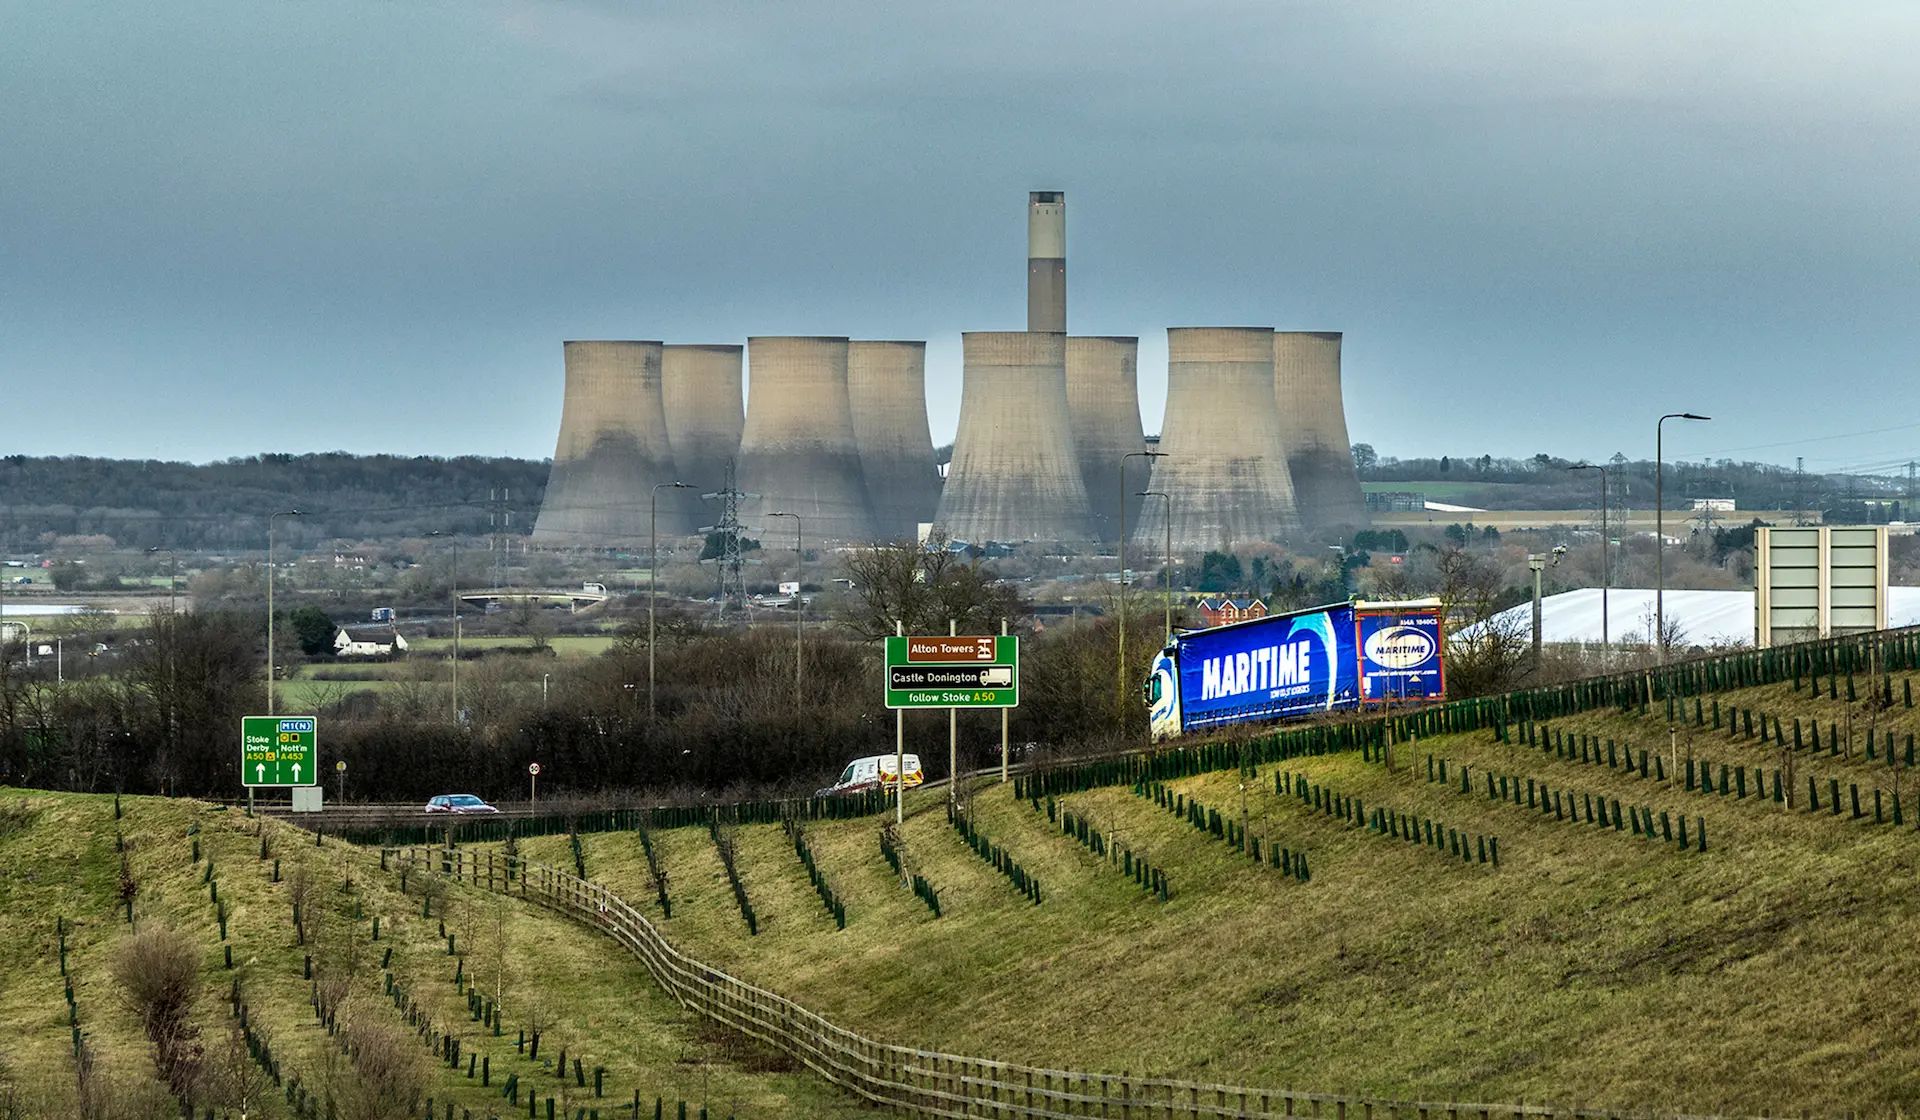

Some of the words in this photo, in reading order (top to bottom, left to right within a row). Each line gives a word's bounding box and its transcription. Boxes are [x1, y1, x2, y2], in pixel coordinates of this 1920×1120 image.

[911, 644, 938, 654] Alton
[940, 643, 974, 654] Towers
[1375, 645, 1426, 655] MARITIME
[1201, 640, 1311, 701] MARITIME
[892, 673, 925, 683] Castle
[927, 673, 978, 684] Donington
[909, 692, 940, 702] follow
[942, 692, 971, 702] Stoke
[973, 692, 996, 702] A50
[282, 722, 311, 731] M1(N)
[246, 735, 270, 744] Stoke
[246, 744, 270, 753] Derby
[280, 744, 308, 752] Nott'm
